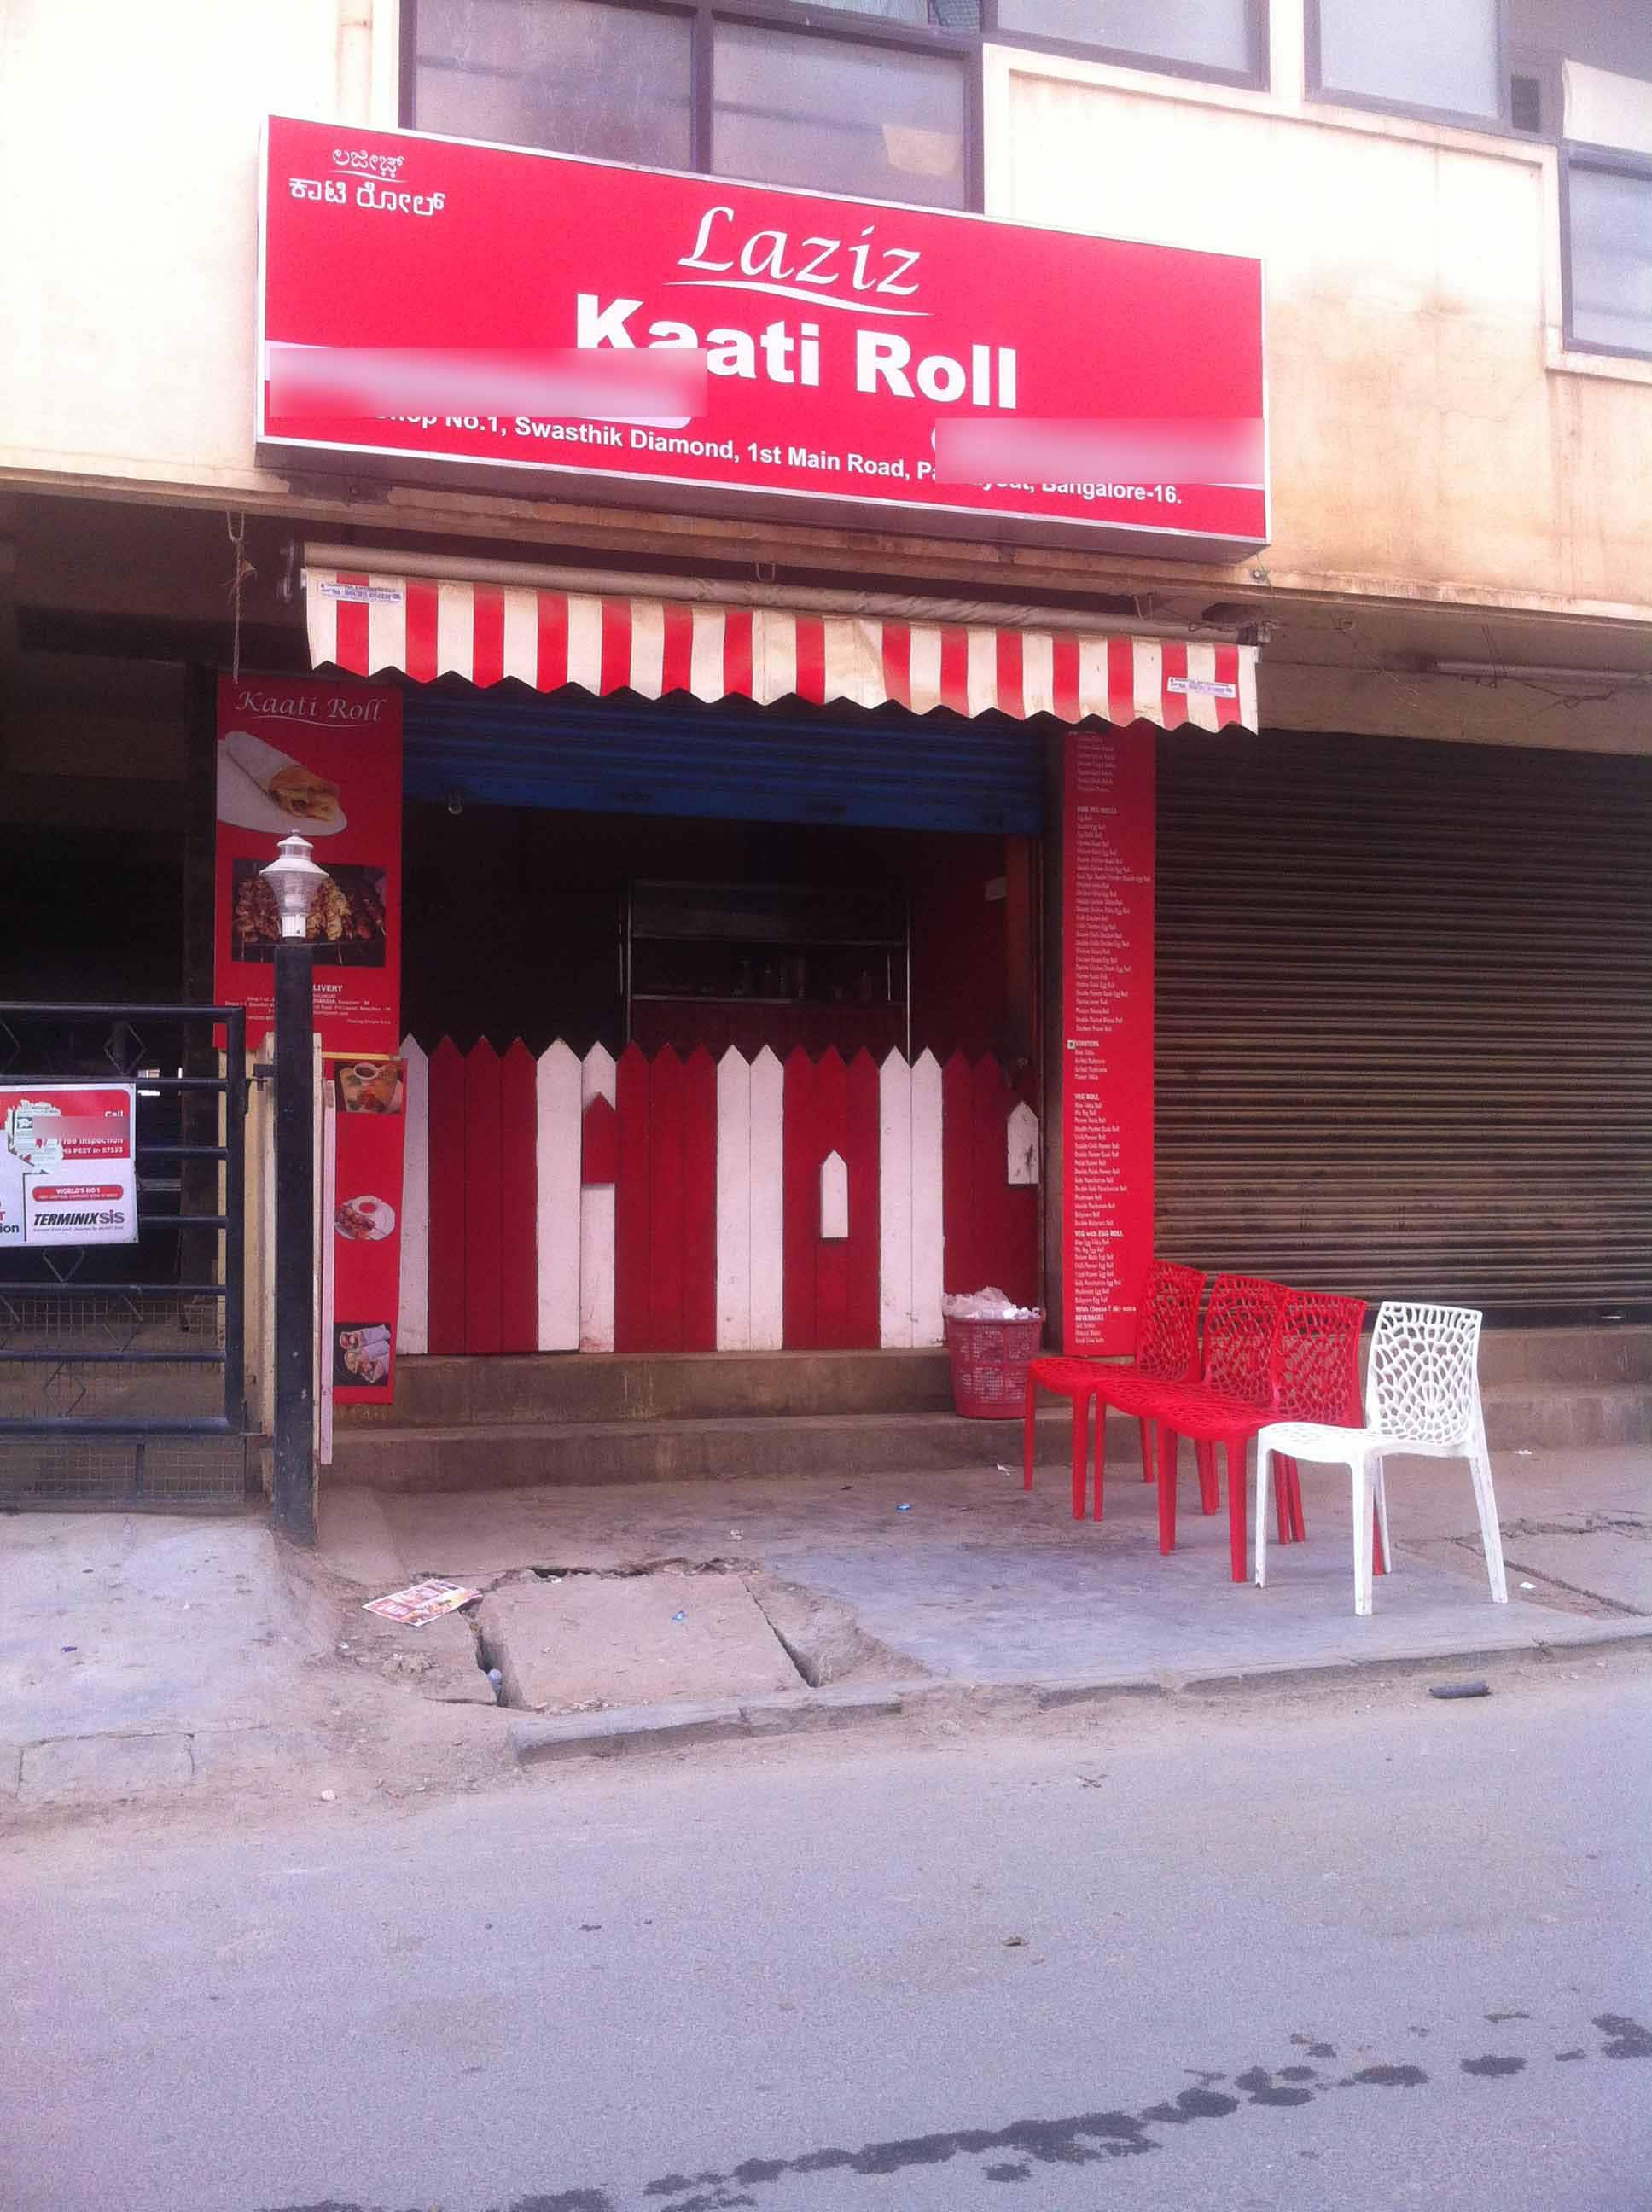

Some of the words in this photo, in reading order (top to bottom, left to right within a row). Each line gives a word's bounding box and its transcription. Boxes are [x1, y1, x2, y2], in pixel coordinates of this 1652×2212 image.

[677, 206, 922, 296] Laziz
[577, 292, 821, 387] Kaati
[856, 329, 1018, 410] Roll
[515, 416, 624, 447] Swasthik
[630, 429, 741, 463] Diamond,
[747, 442, 782, 465] 1st
[788, 446, 841, 472] Main
[847, 453, 910, 480] Road,
[235, 691, 319, 717] Kaati
[327, 696, 387, 723] Roll
[313, 984, 343, 992] LIVERY
